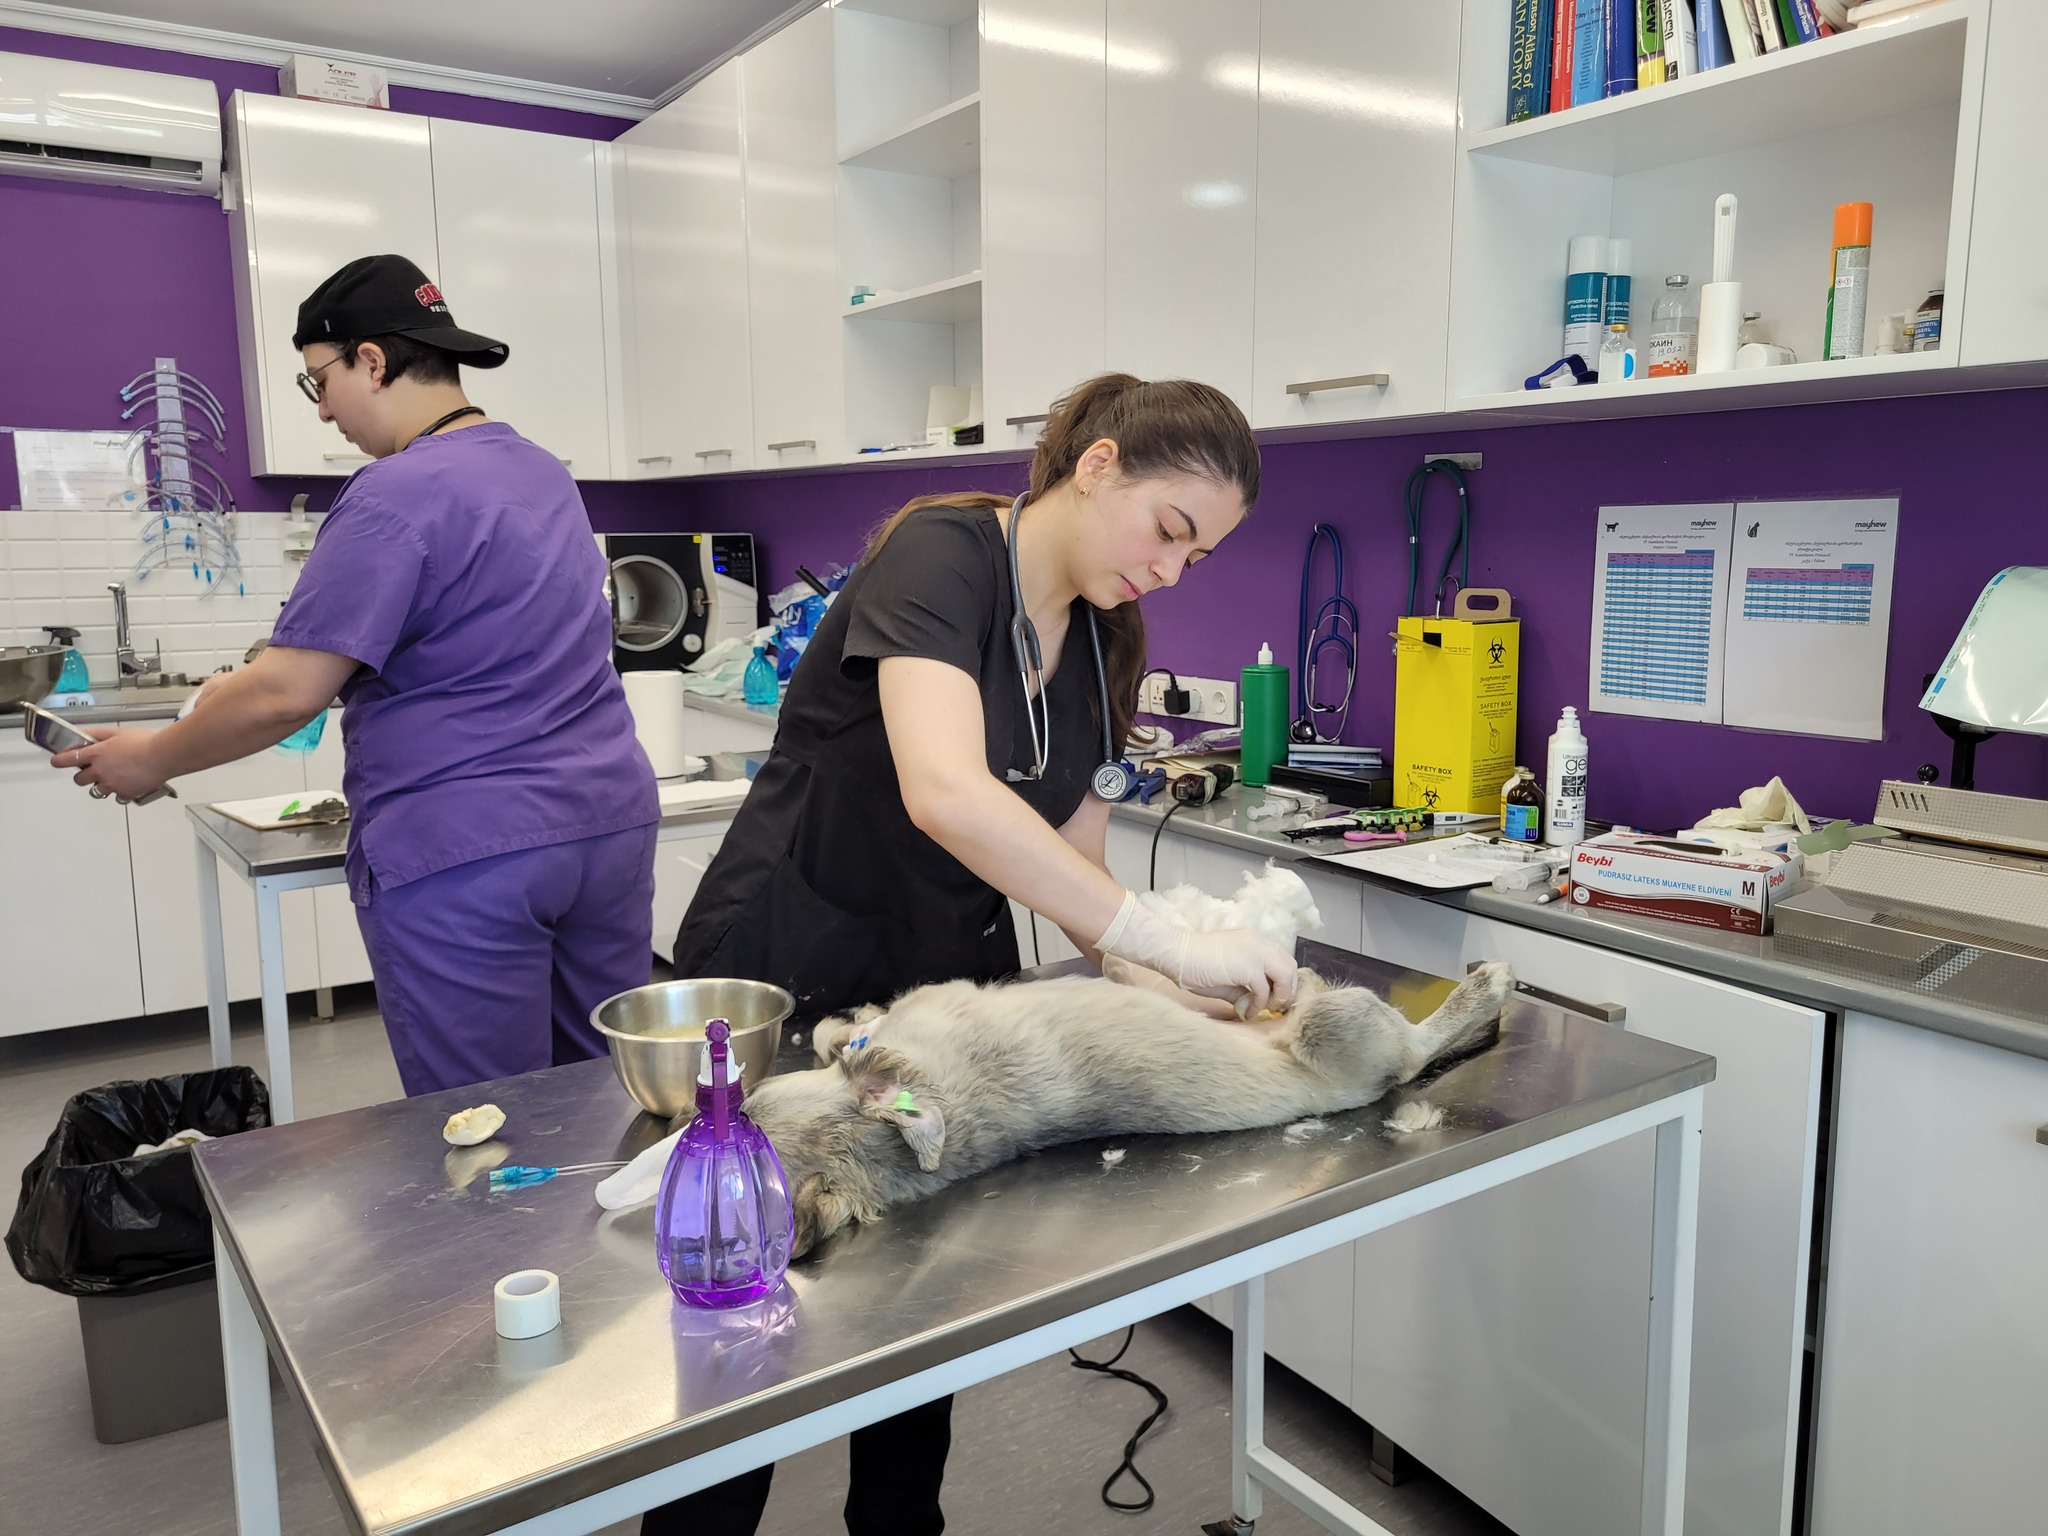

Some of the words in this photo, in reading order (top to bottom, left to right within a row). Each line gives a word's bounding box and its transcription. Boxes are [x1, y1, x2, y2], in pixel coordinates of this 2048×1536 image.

[1530, 0, 1538, 32] ERSON
[1646, 0, 1657, 33] ew
[1511, 0, 1526, 91] ANATOMY
[1524, 34, 1536, 70] Atlas
[1523, 73, 1533, 89] of
[1690, 518, 1717, 528] mayhew
[1854, 519, 1888, 530] mayhew
[1480, 702, 1500, 710] SAFETY
[1500, 700, 1512, 708] BOX
[1411, 763, 1437, 774] SAFETY
[1438, 767, 1453, 776] BOX
[1577, 852, 1614, 867] Beybi
[1746, 863, 1762, 871] M
[1598, 869, 1633, 881] PUDRASIZ
[1633, 874, 1661, 886] LATEKS
[1661, 878, 1697, 892] MUAYENE
[1769, 869, 1785, 888] Beybi
[1741, 880, 1755, 897] M
